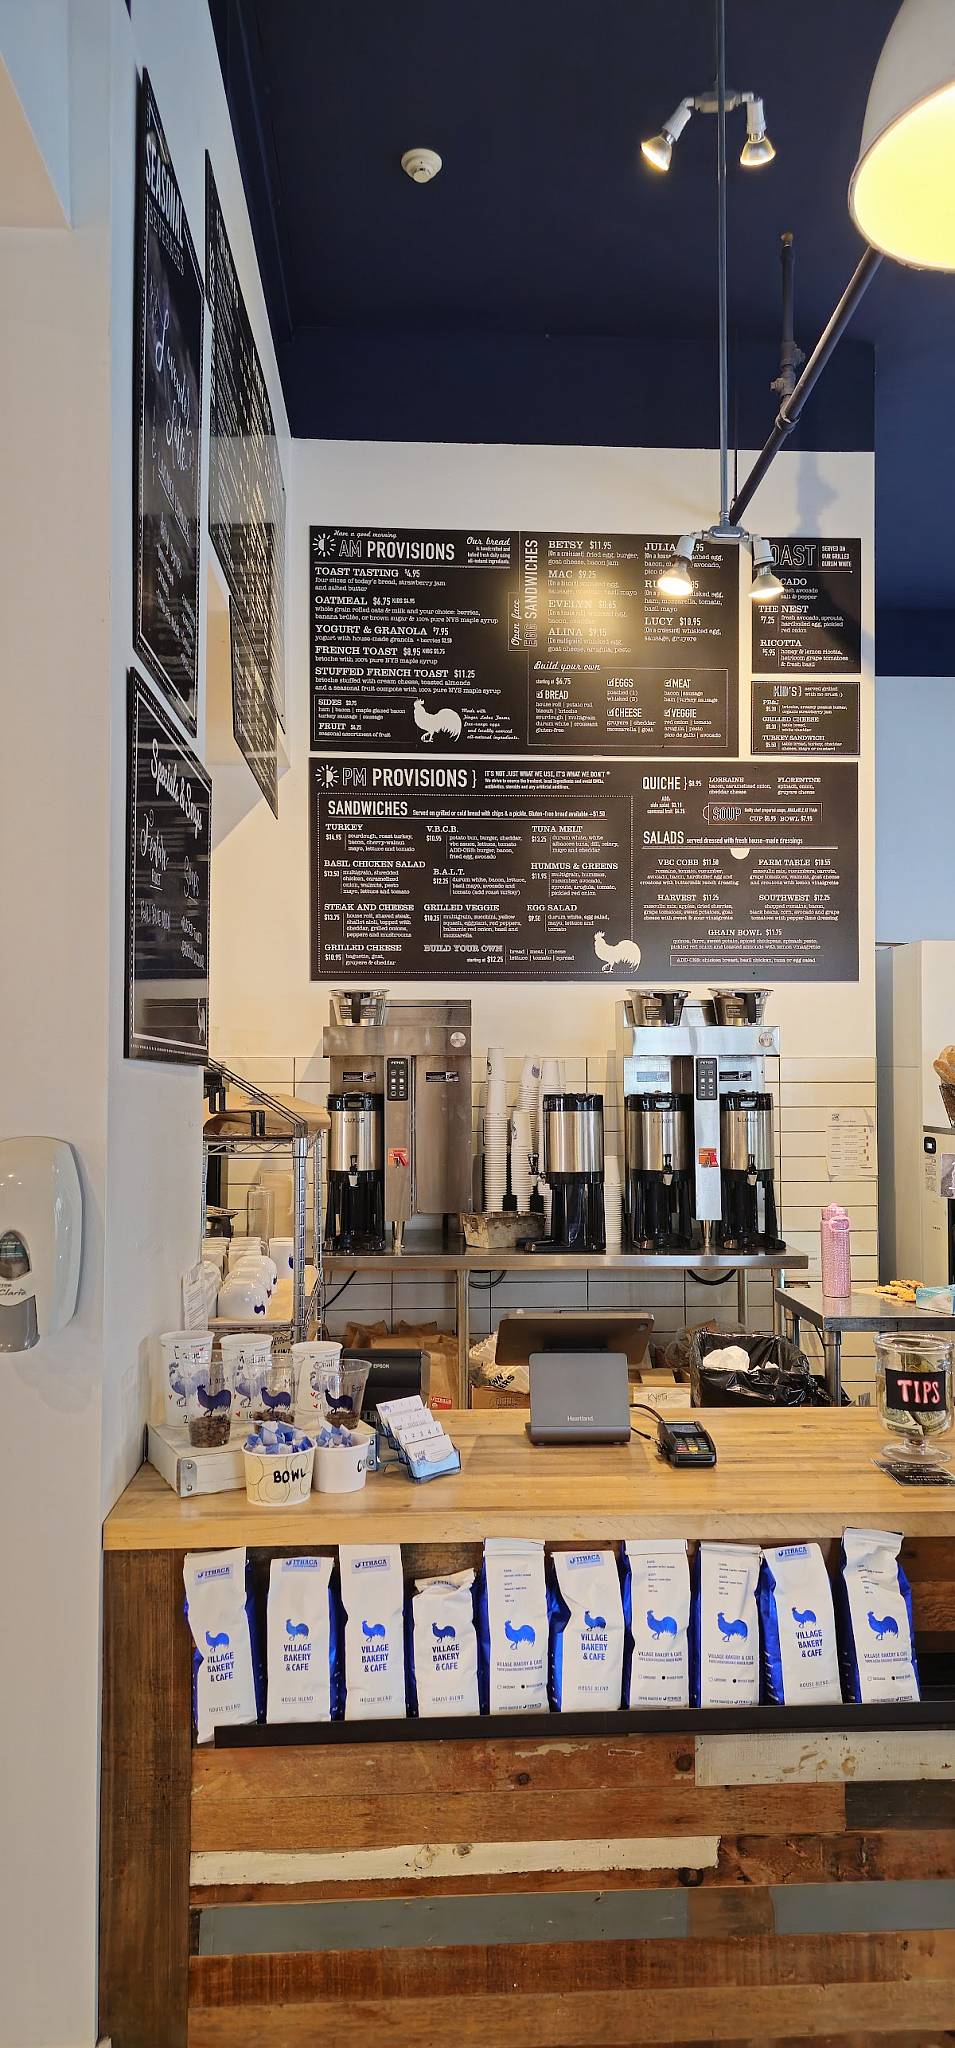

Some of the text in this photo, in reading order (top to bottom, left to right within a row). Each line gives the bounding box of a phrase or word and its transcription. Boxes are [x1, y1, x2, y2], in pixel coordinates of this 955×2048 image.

[146, 134, 184, 248] SEASONAL
[466, 536, 510, 546] Our bread
[548, 540, 612, 550] BETSY $11.95
[339, 540, 455, 560] AM PROVISIONS
[644, 542, 676, 551] JULIA
[771, 544, 816, 566] OAST
[314, 567, 420, 578] TOAST TASTING $4.95
[548, 570, 572, 578] MAC
[524, 540, 538, 647] EGG SANDWICHES
[315, 596, 390, 606] OATMEAL $6.75
[548, 600, 592, 608] EVELYN
[645, 617, 701, 626] LUCY $10.95
[315, 624, 449, 636] YOGURT & GRANOLA $7.95
[511, 623, 522, 646] Open
[548, 628, 582, 636] ALINA
[315, 646, 398, 656] FRENCH TOAST
[534, 660, 558, 670] Build
[560, 663, 582, 672] your
[315, 666, 476, 678] STUFFED FRENCH TOAST $11.25
[614, 678, 634, 688] EGGS
[672, 678, 692, 688] MEAT
[545, 690, 568, 700] BREAD
[614, 708, 642, 718] CHEESE
[672, 708, 696, 718] VEGGIE
[342, 768, 366, 786] PM
[372, 768, 468, 788] PROVISIONS
[642, 776, 681, 790] QUICHE
[151, 738, 179, 802] Specials
[185, 782, 203, 839] Soups
[328, 800, 408, 816] SANDWICHES
[712, 807, 742, 820] SOUP
[644, 831, 684, 844] SALADS
[481, 944, 502, 952] OWN
[897, 1380, 940, 1404] TIPS
[274, 1468, 306, 1484] BOWL
[784, 1546, 807, 1556] ITHACA
[362, 1558, 387, 1567] ITHACA
[576, 1554, 600, 1563] ITHACA
[204, 1568, 230, 1578] ITHACA
[581, 1633, 608, 1642] VILLAGE
[796, 1630, 822, 1640] VILLAGE
[284, 1644, 312, 1652] VILLAGE
[362, 1644, 389, 1654] VILLAGE
[432, 1644, 460, 1653] VILLAGE
[581, 1643, 608, 1652] BAKERY
[798, 1640, 822, 1648] BAKERY
[284, 1653, 311, 1662] BAKERY
[432, 1652, 460, 1662] BAKERY
[808, 1649, 822, 1657] CAFE
[362, 1654, 389, 1664] BAKERY
[208, 1662, 234, 1672] BAKERY
[292, 1662, 309, 1671] CAFE
[364, 1664, 387, 1672] & CAFE
[436, 1662, 458, 1671] & CAFE
[216, 1672, 234, 1681] CAFE
